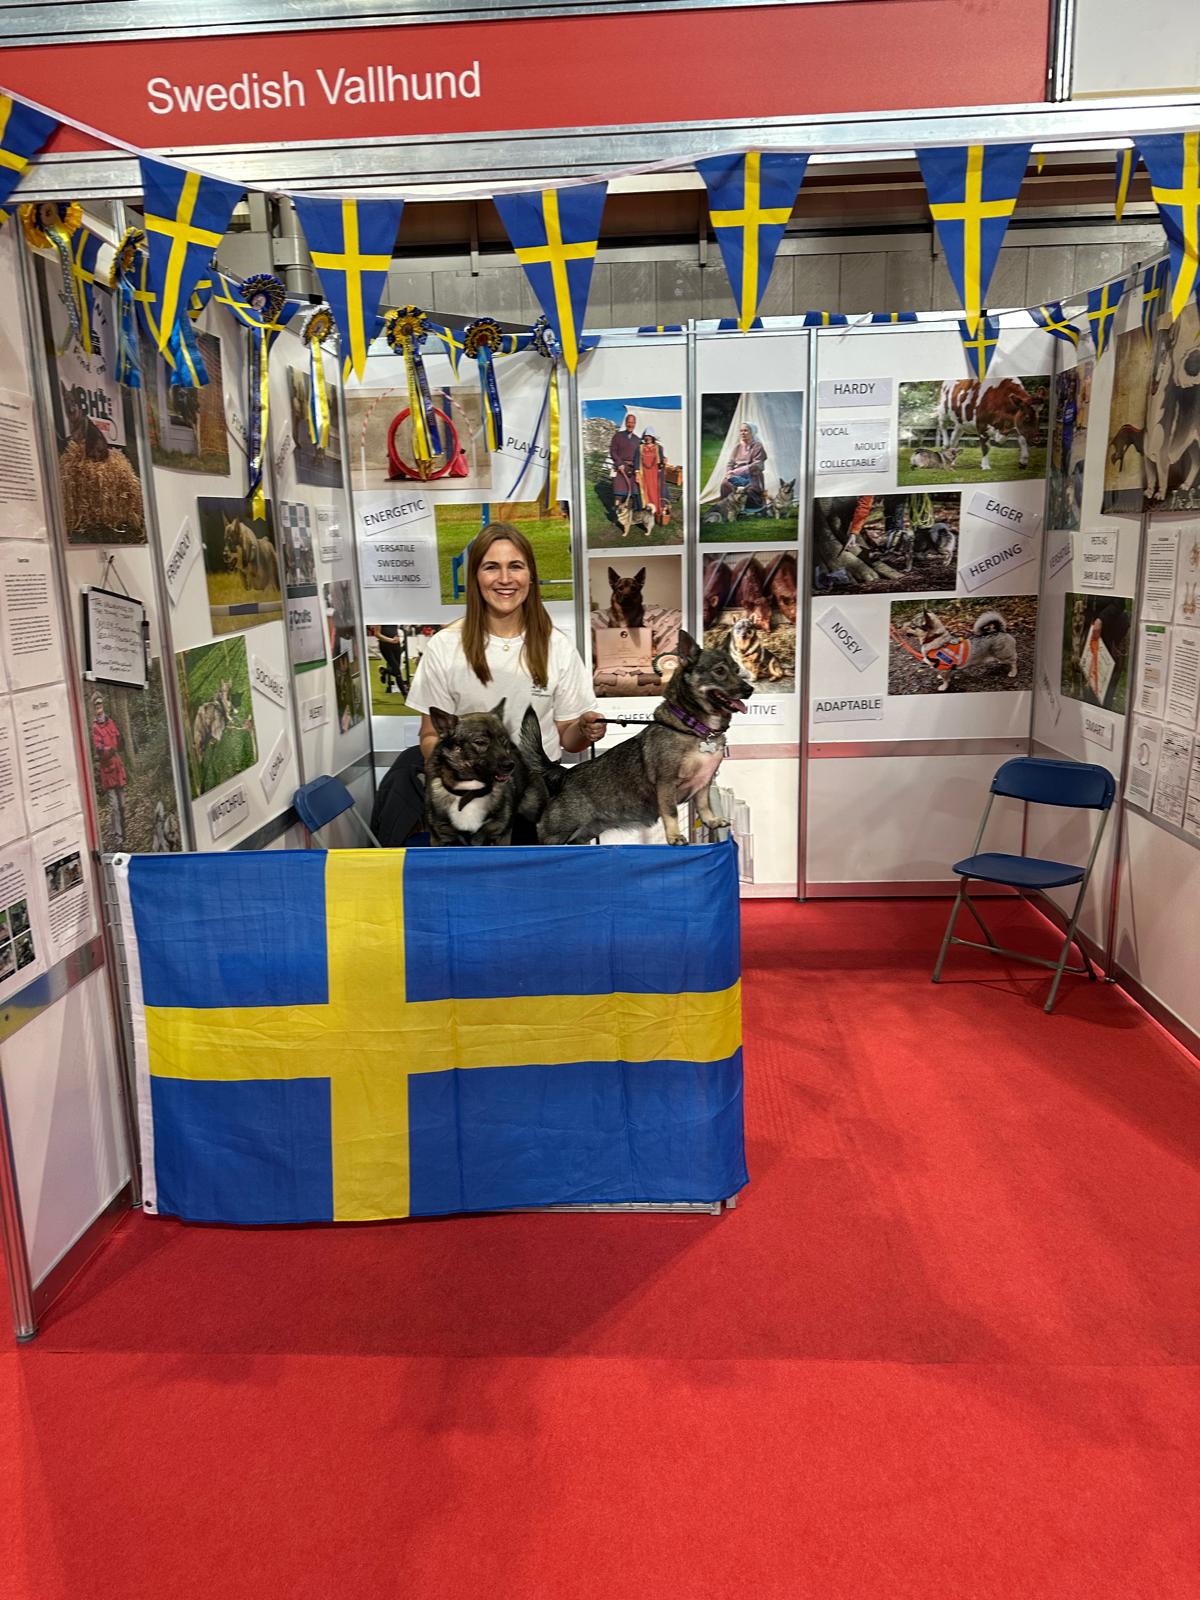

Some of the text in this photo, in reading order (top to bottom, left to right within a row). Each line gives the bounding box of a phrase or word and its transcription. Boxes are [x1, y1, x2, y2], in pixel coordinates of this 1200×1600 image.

[147, 60, 482, 115] Swedish Vallhund
[833, 382, 876, 396] HARDY
[820, 427, 849, 438] VOCAL
[854, 441, 886, 451] MOULT
[819, 458, 876, 469] COLLECTABLE
[363, 499, 425, 526] ENERGETIC
[985, 499, 1024, 524] EAGER
[373, 544, 416, 553] VERSATILE
[376, 559, 415, 569] SWEDISH
[968, 543, 1023, 577] HERDING
[372, 573, 422, 583] VALLHUNDS
[830, 621, 863, 655] NOSEY
[815, 698, 881, 713] ADAPTABLE
